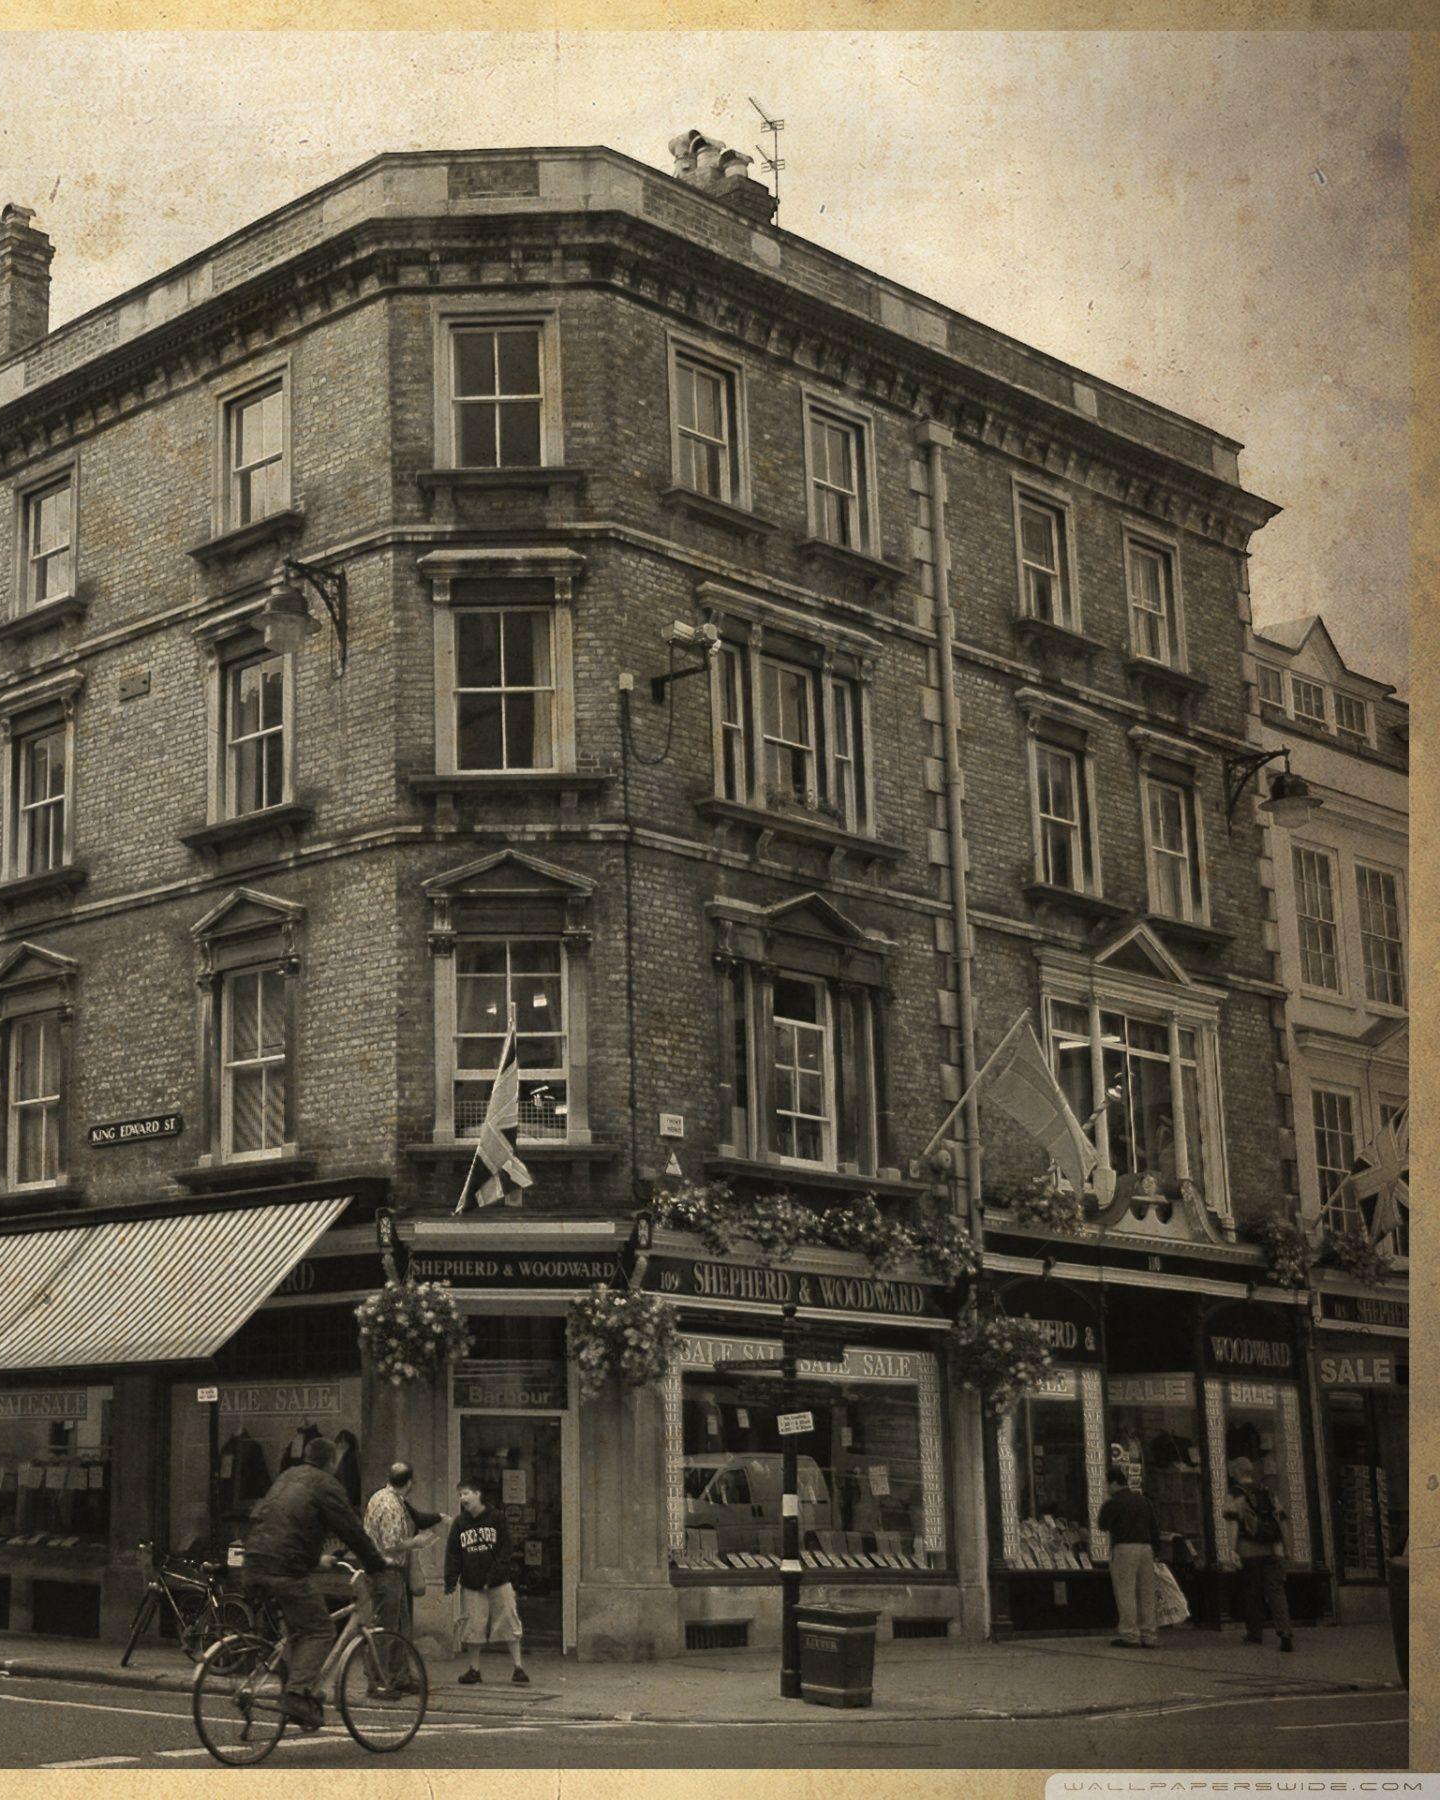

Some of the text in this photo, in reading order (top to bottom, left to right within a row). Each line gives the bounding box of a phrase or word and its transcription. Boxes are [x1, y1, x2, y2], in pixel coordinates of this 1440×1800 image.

[92, 1118, 176, 1142] KING EDWARD ST
[411, 1260, 616, 1279] SHEPHERD & WOODWARD
[660, 1261, 925, 1314] 109 SHEPHERD & WOODWARD
[680, 1338, 733, 1363] SALE
[863, 1352, 911, 1378] SALE
[1210, 1336, 1291, 1368] WOODWARD
[1320, 1357, 1392, 1383] SALE
[219, 1389, 261, 1412] ALE
[274, 1382, 332, 1411] SALE
[469, 1385, 553, 1405] Barbour
[1107, 1380, 1187, 1401] SALE
[1229, 1382, 1275, 1405] SALE
[805, 1636, 839, 1651] LITTER
